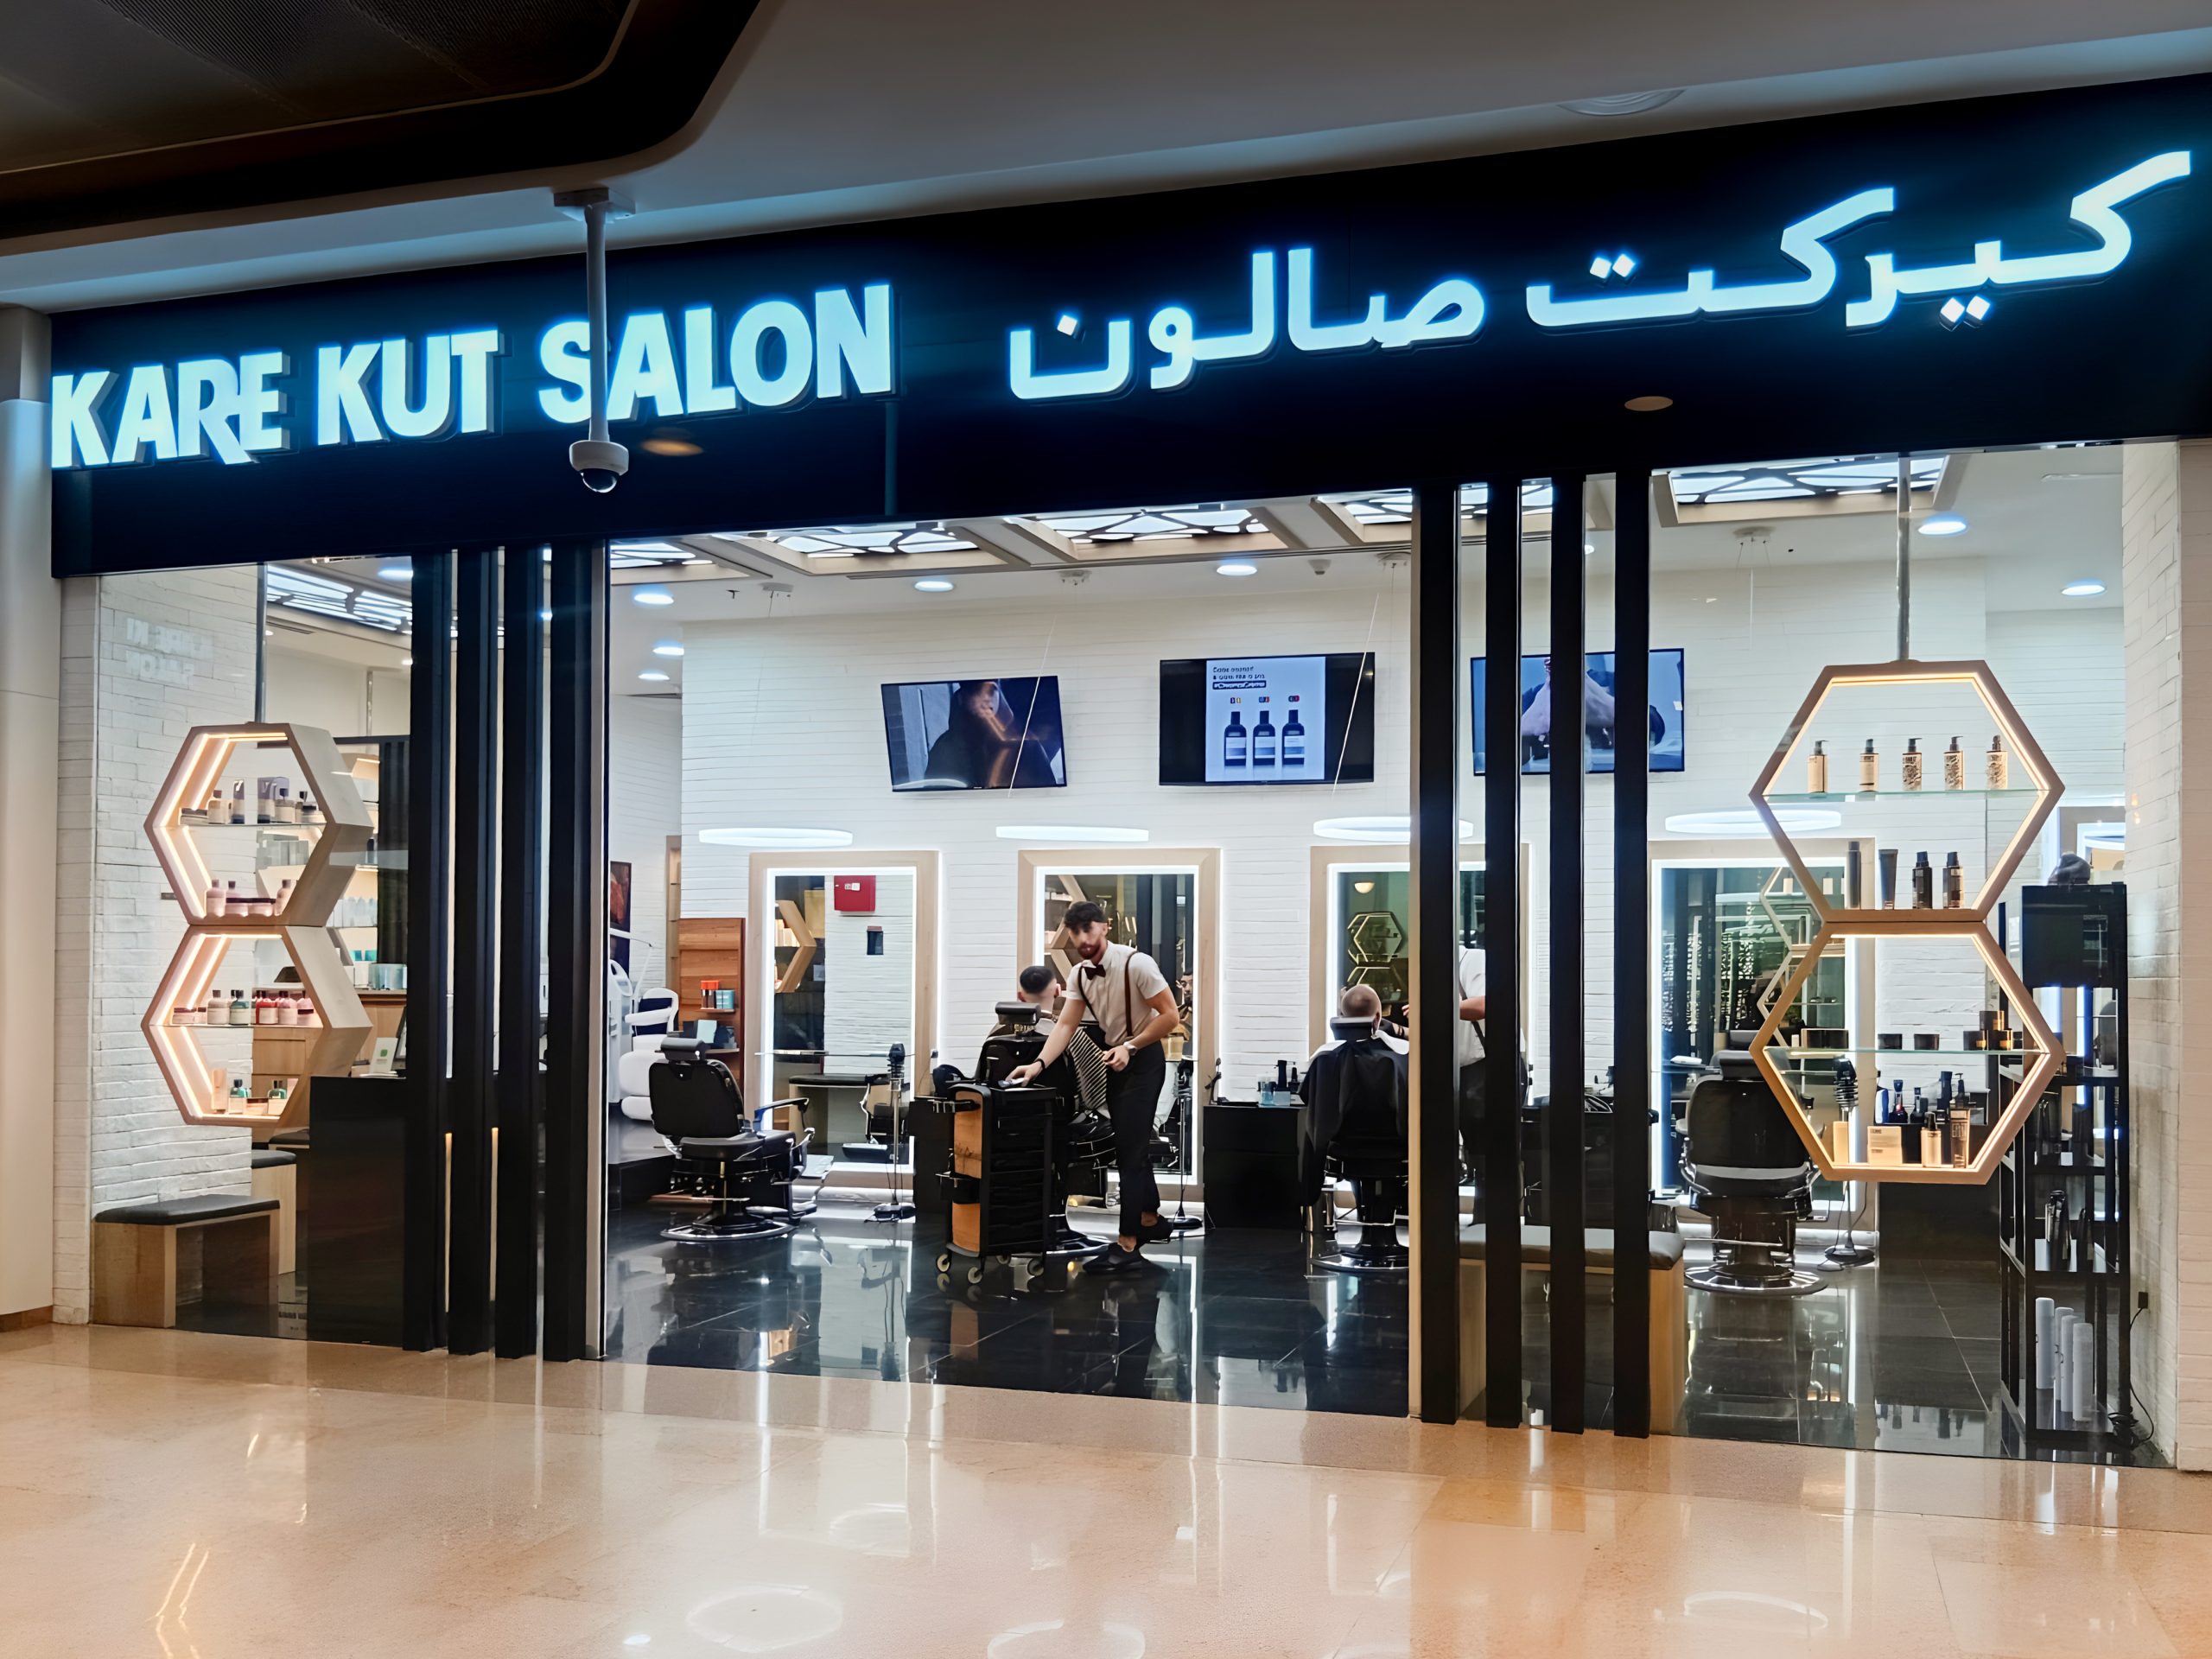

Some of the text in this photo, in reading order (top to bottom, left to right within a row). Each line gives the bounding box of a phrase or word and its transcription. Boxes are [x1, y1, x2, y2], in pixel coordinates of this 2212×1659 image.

[51, 284, 892, 468] KARE KUT SALON
[1009, 150, 2191, 400] كيركت صالون
